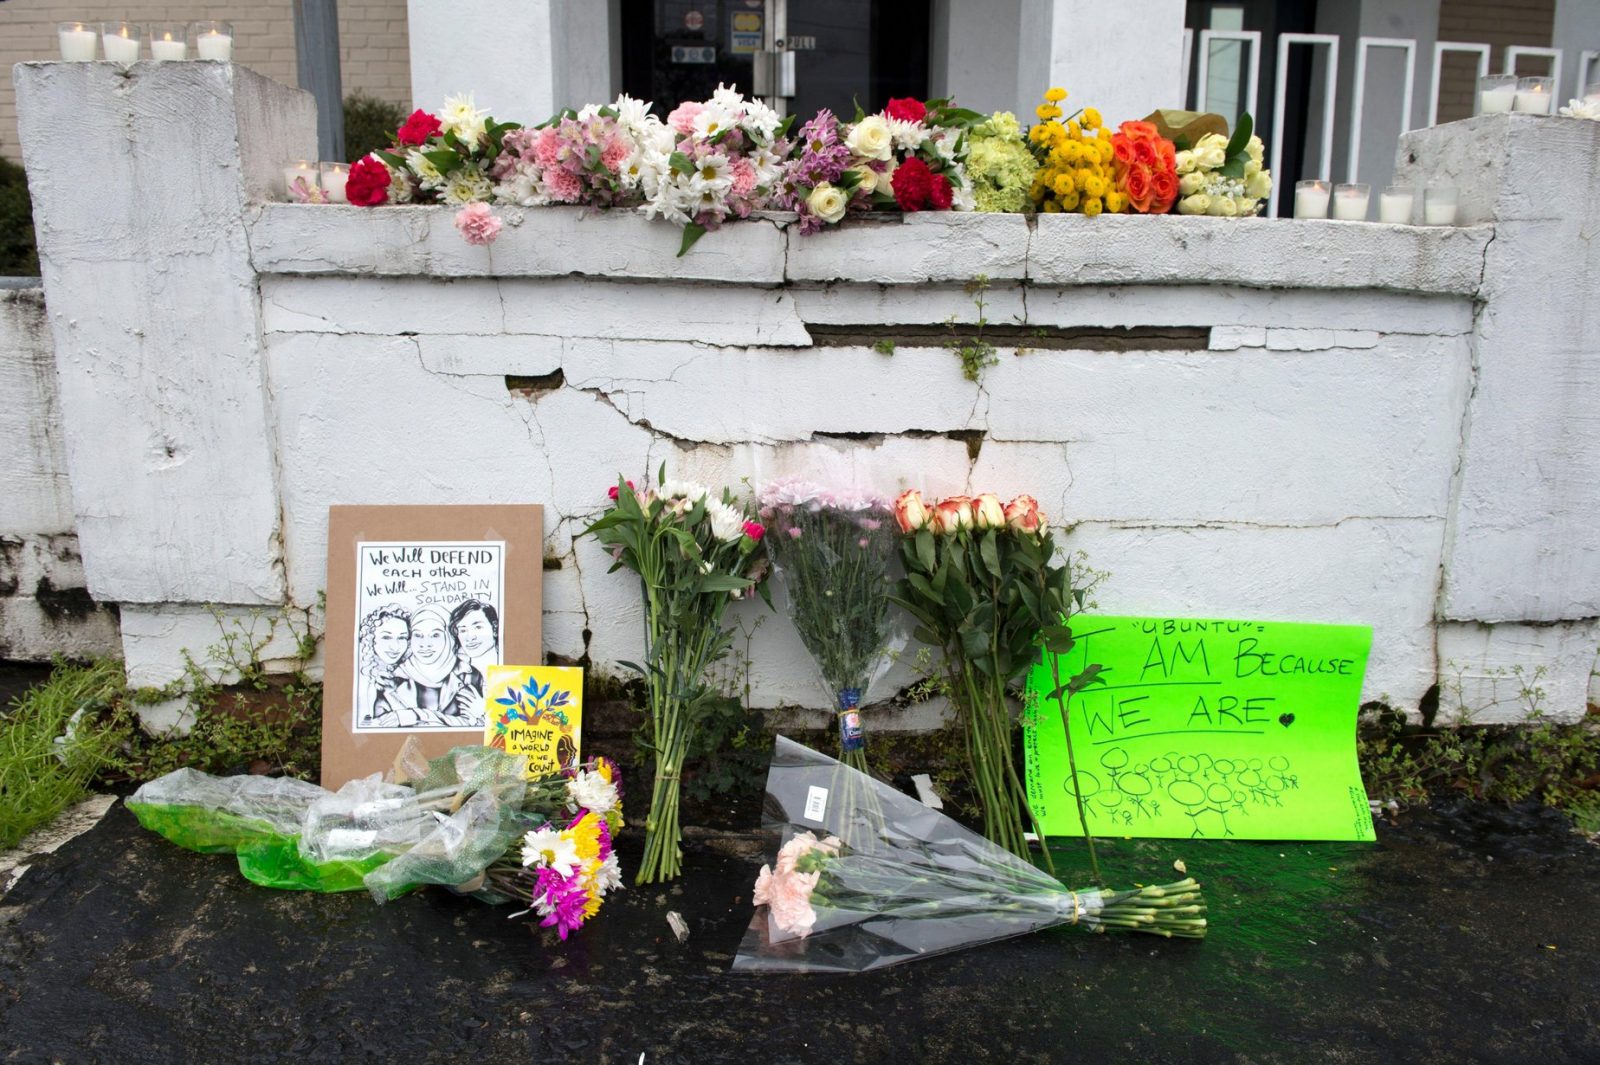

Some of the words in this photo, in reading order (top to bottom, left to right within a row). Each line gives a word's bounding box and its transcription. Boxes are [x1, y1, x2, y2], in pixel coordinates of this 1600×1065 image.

[369, 550, 389, 565] We
[392, 547, 425, 564] Will
[366, 584, 382, 597] We
[420, 580, 467, 594] STAND
[473, 578, 490, 590] IN
[415, 591, 493, 605] SOLIDARITY
[1140, 636, 1211, 681] AM
[1081, 695, 1151, 737] WE
[520, 743, 550, 752] WORLD
